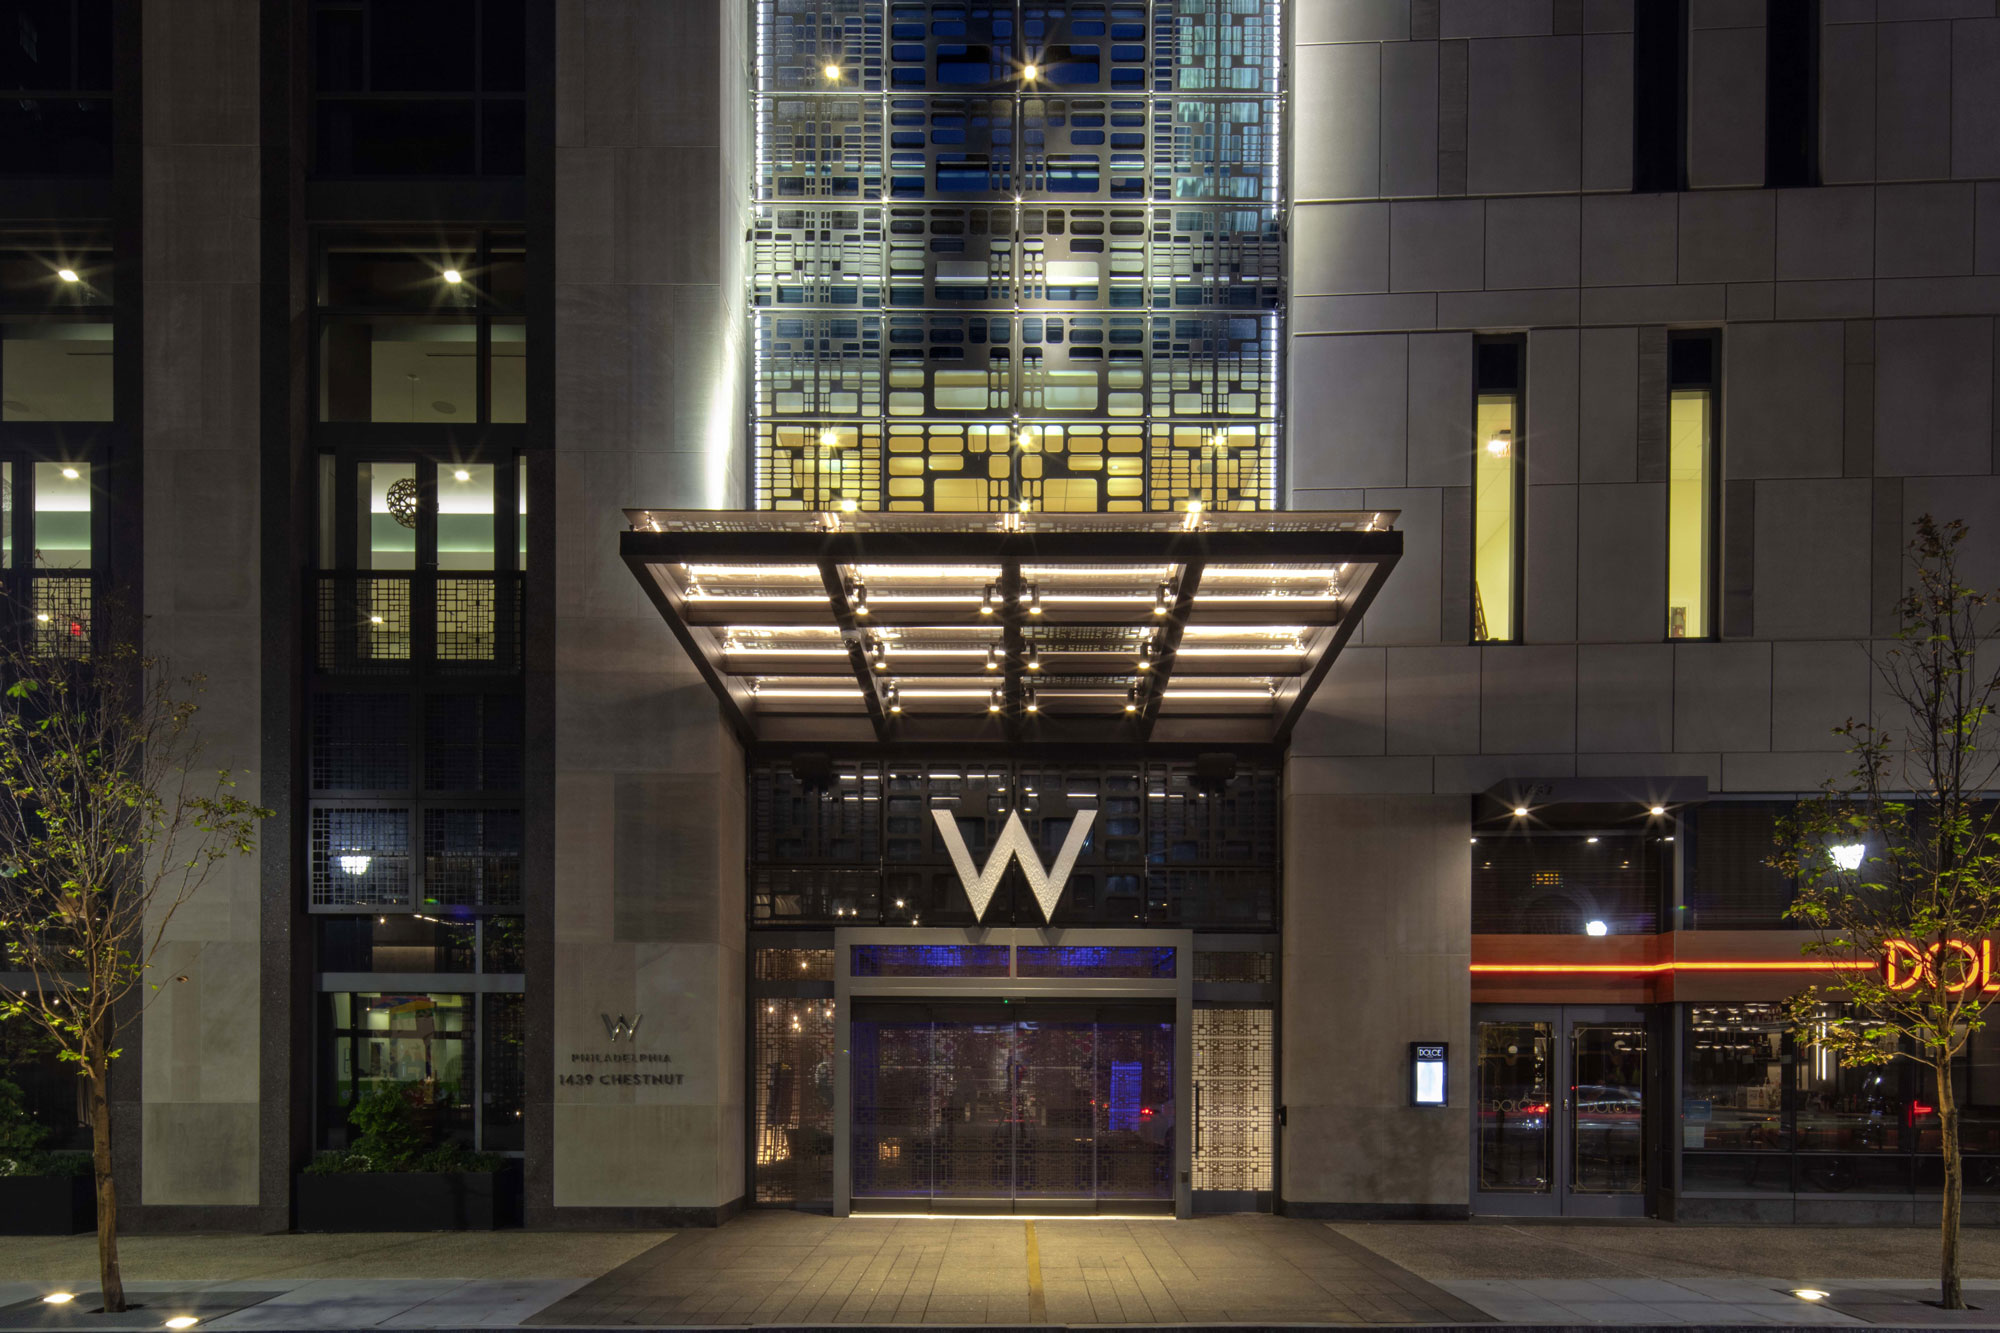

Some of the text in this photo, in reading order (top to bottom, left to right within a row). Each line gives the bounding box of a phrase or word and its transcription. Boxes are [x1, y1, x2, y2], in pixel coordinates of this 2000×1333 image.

[931, 809, 1098, 923] W
[601, 1013, 643, 1042] W
[571, 1053, 672, 1064] PHILADELPHIA
[559, 1073, 685, 1086] 1439 CHESTNUT
